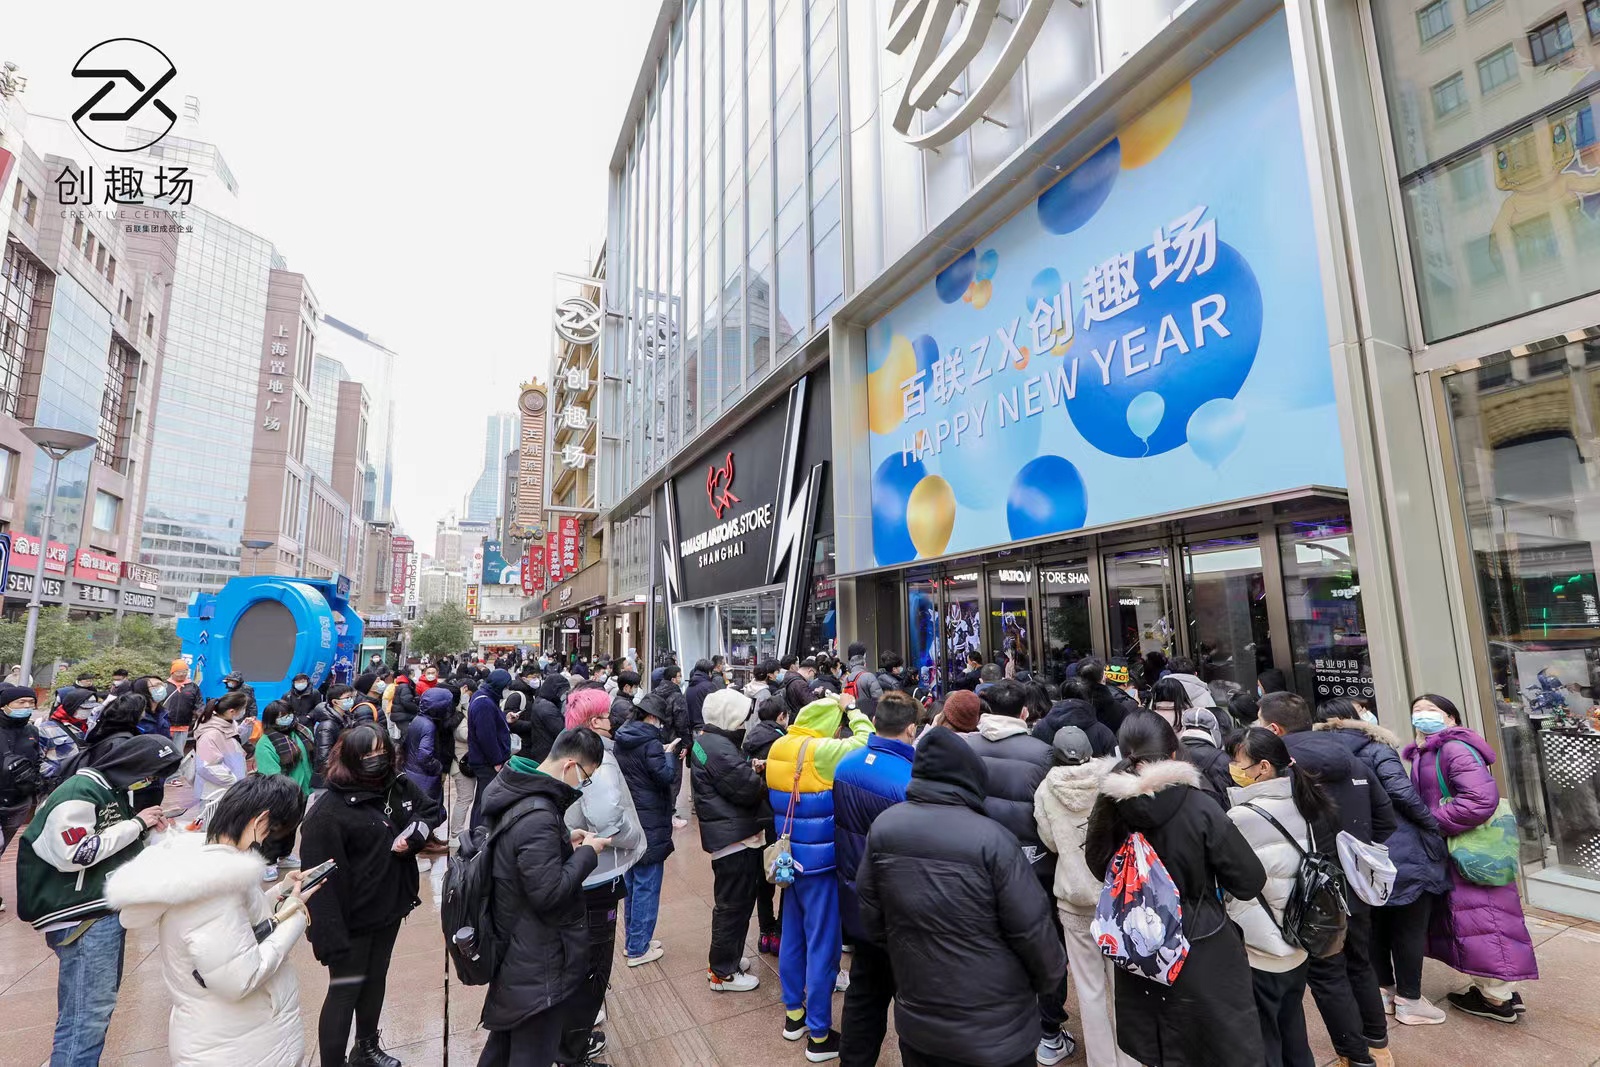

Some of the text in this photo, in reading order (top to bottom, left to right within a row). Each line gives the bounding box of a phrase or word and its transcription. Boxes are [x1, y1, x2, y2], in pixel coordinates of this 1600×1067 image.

[263, 323, 289, 432] 上海置地广场
[900, 292, 1232, 468] HAPPY NEW YEAR
[561, 365, 590, 470] 创趣场
[740, 503, 772, 535] STORE
[698, 540, 744, 568] SHANGHAI
[9, 574, 61, 596] SENNES
[409, 559, 418, 600] BOSIDENG
[124, 592, 155, 608] SENDNES
[1315, 659, 1358, 669] 营业时间
[1316, 675, 1373, 684] 10:00-22:00
